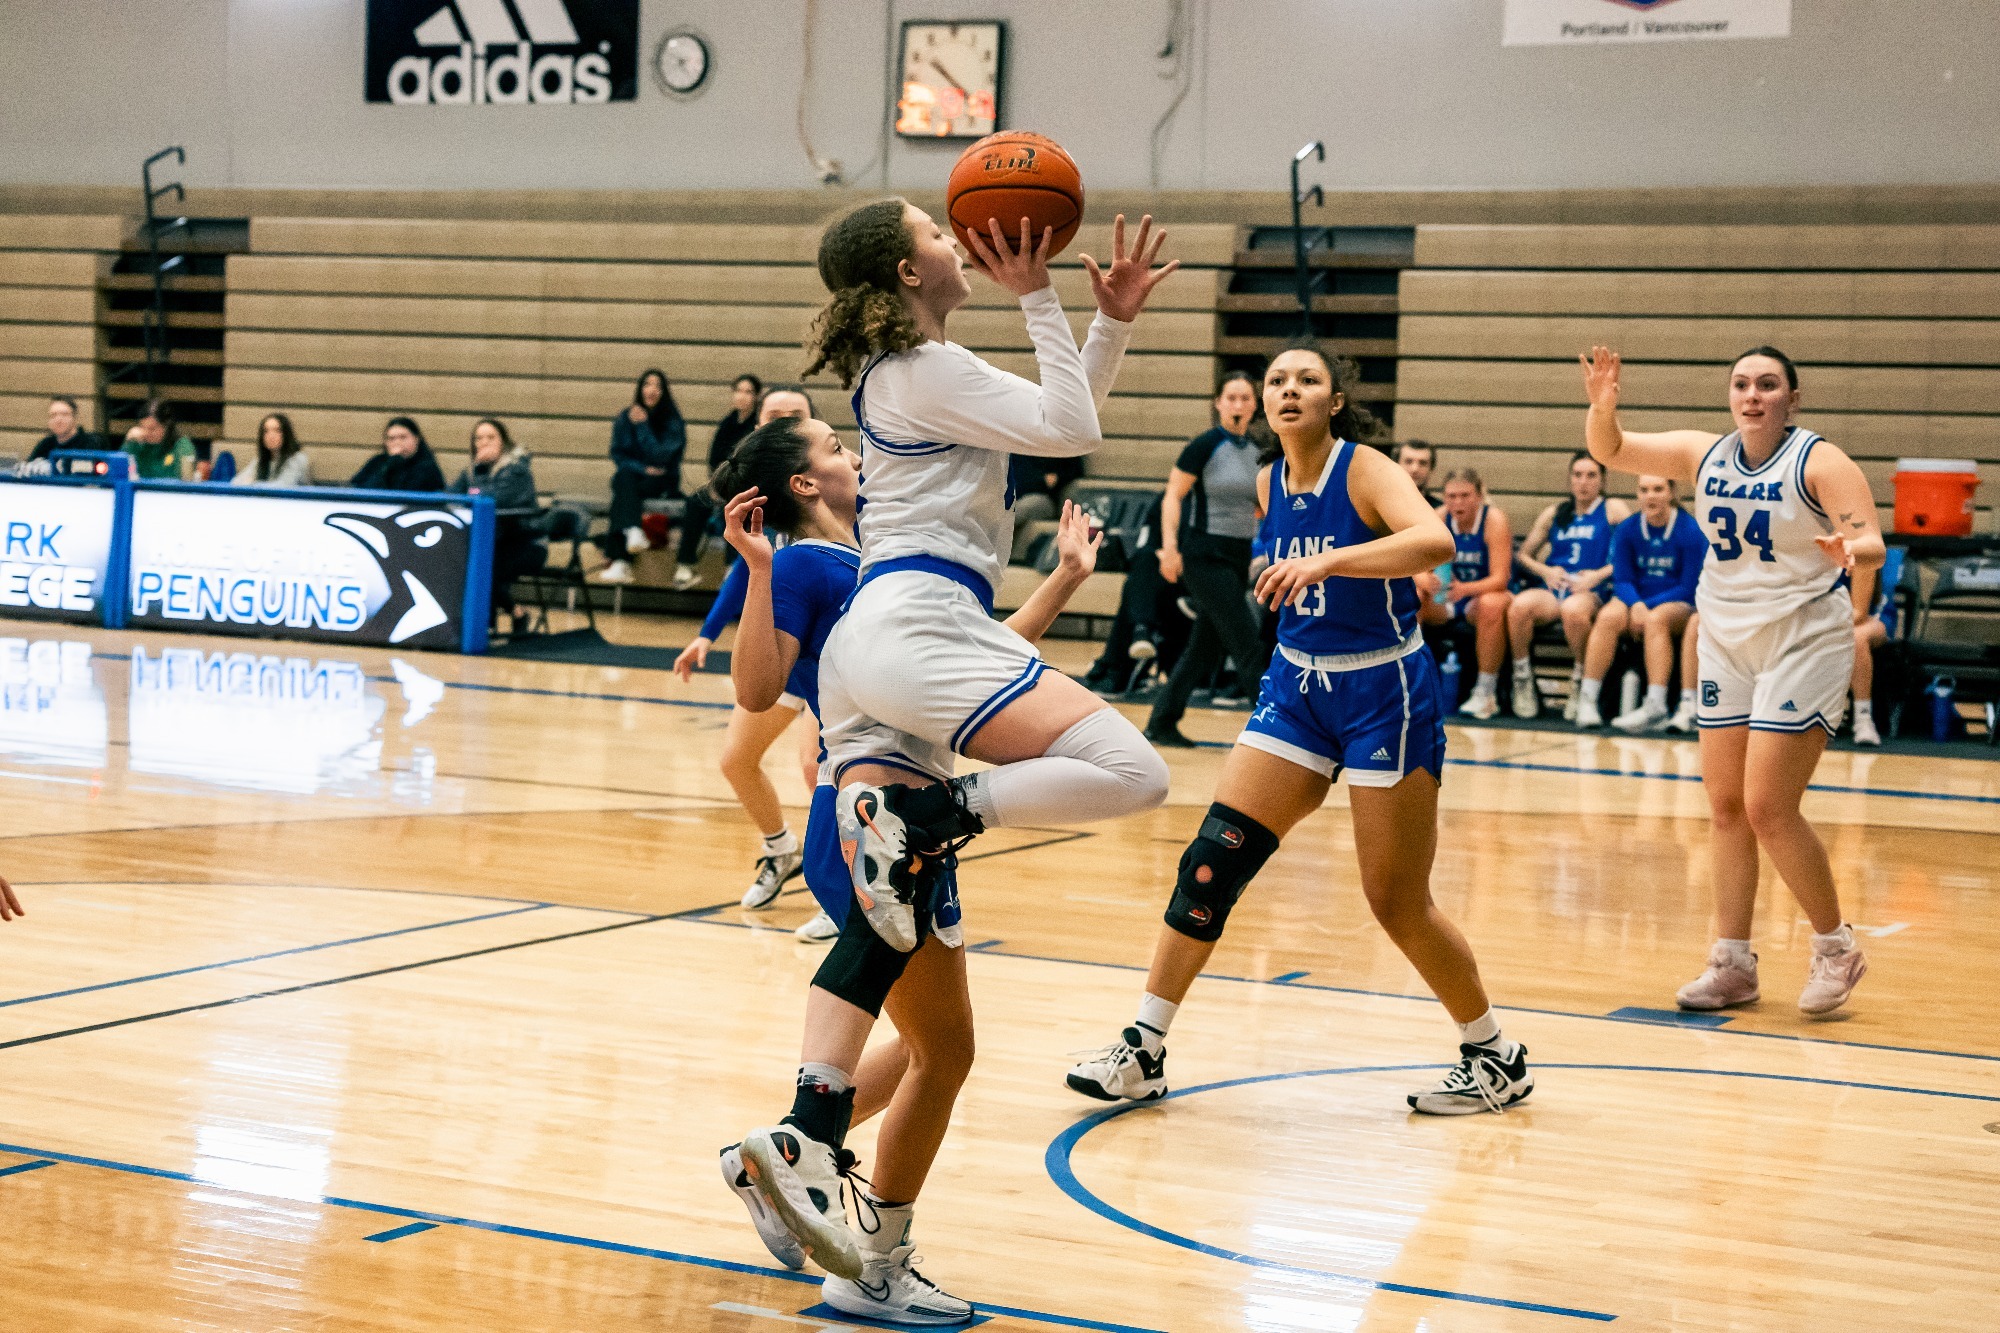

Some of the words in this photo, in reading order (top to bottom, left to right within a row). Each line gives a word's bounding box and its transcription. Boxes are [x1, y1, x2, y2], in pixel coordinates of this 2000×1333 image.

[387, 41, 611, 103] adidas
[1705, 477, 1783, 501] CLARK
[1708, 506, 1777, 562] 34
[134, 571, 365, 629] PENGUINS
[1294, 581, 1326, 617] 23
